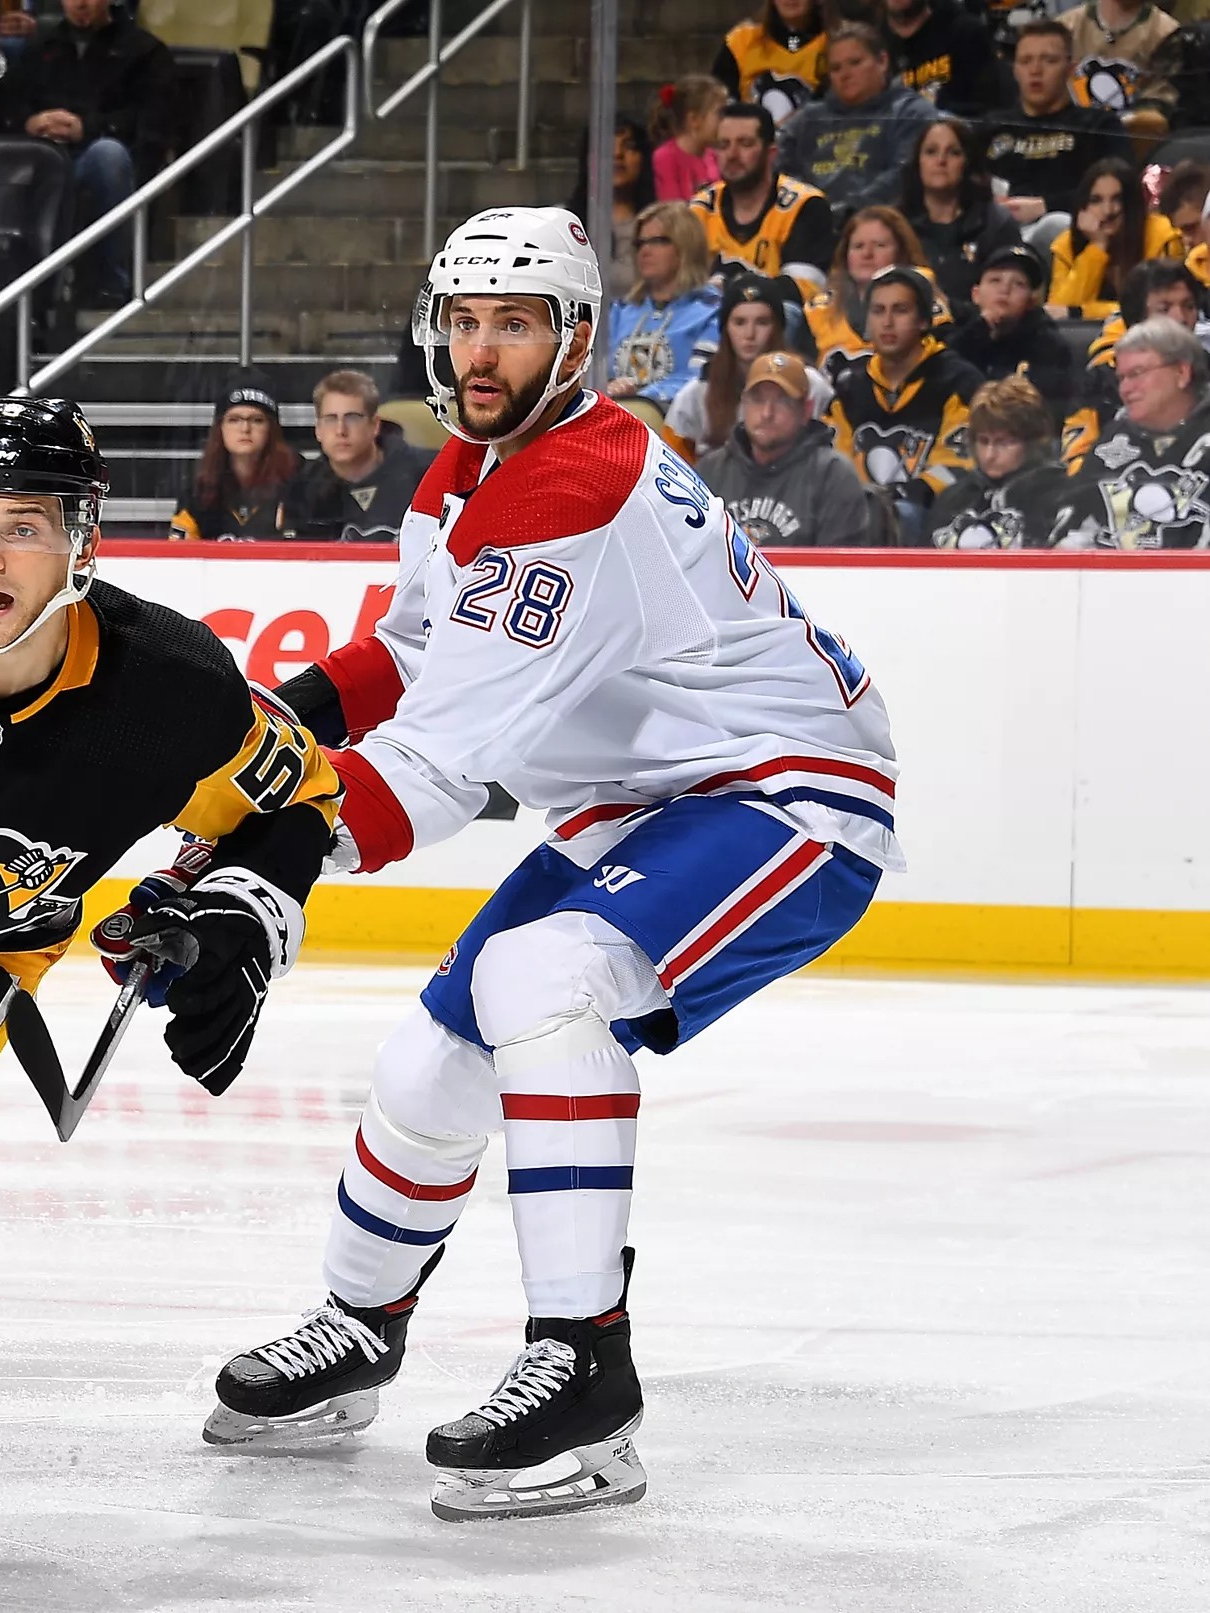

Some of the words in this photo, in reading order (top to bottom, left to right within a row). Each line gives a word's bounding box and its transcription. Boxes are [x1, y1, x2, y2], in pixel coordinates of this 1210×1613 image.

[453, 256, 501, 266] CCM
[449, 550, 575, 650] 28
[229, 712, 309, 814] 5
